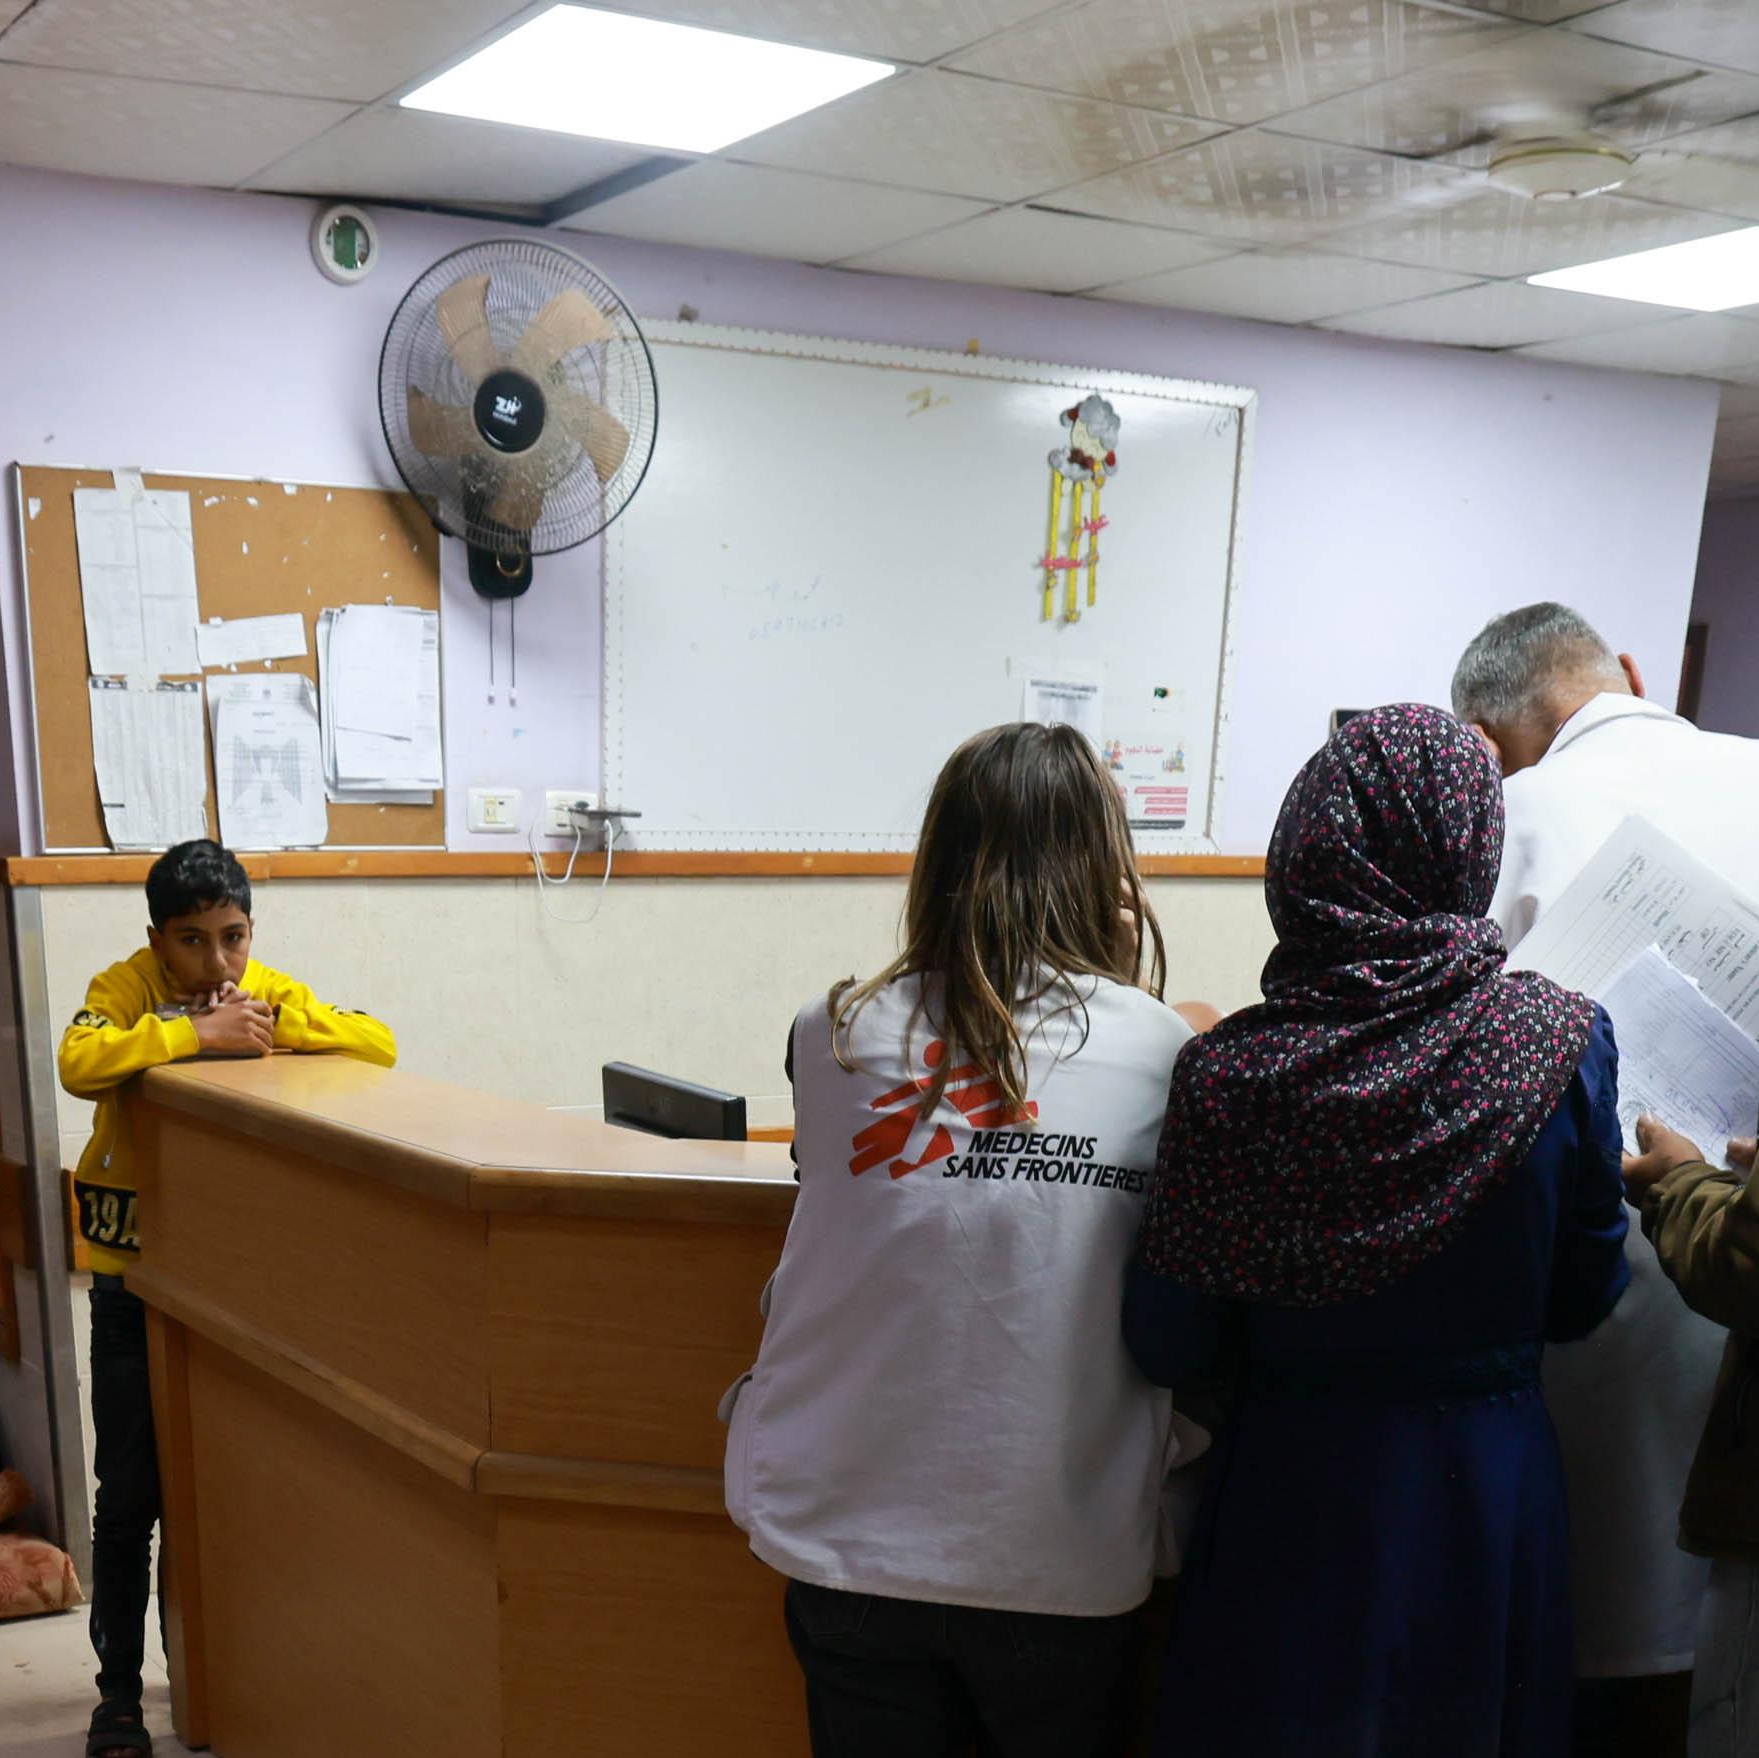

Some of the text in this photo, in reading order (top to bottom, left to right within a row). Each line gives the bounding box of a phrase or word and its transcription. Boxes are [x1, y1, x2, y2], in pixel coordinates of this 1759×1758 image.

[967, 1131, 1097, 1159] MEDECINS
[943, 1156, 1148, 1193] SANS FRONTIERES
